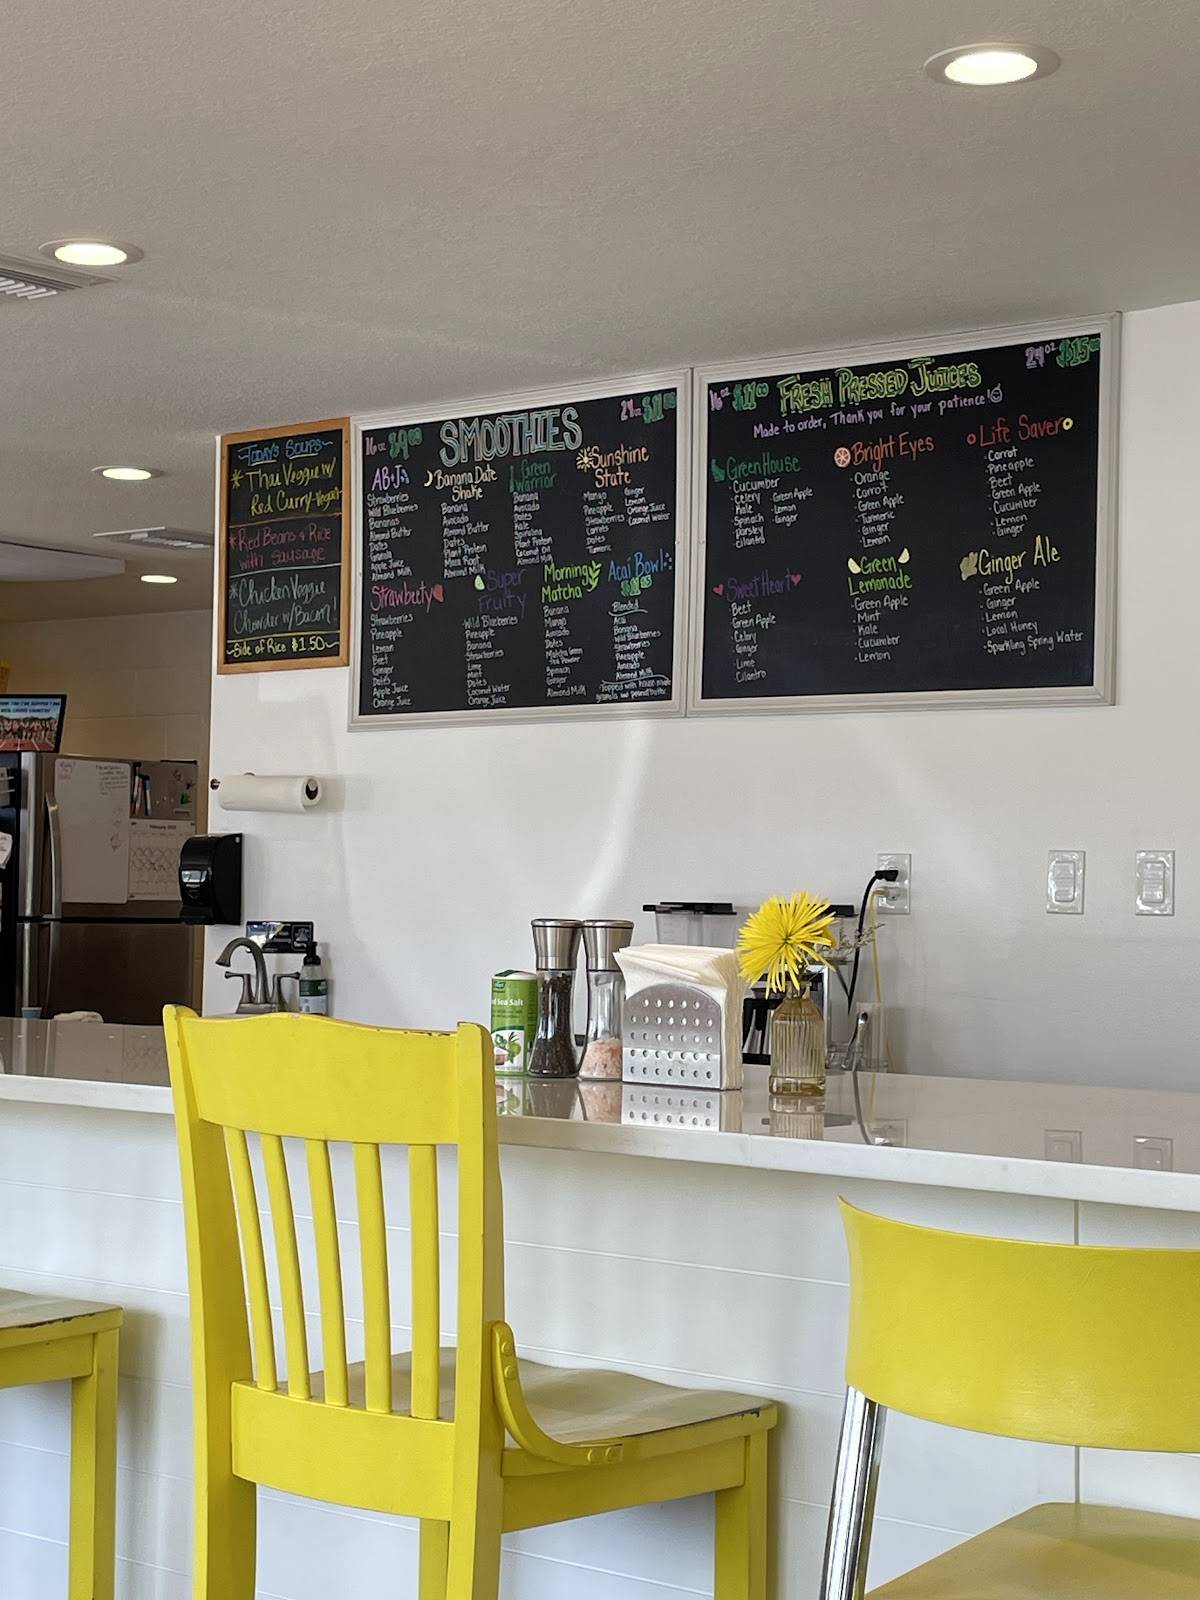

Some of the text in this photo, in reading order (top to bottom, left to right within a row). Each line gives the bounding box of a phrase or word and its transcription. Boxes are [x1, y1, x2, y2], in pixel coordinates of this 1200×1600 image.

[777, 374, 833, 417] FRESH
[835, 369, 908, 408] PRESSED
[754, 423, 780, 438] Made
[783, 420, 795, 433] to
[829, 408, 865, 425] Thank
[867, 409, 883, 424] you
[890, 401, 906, 417] for
[910, 402, 932, 418] your
[439, 406, 582, 468] SMOOTHIES
[980, 414, 1064, 447] Life Saver
[590, 443, 649, 469] Sunshine
[851, 432, 934, 472] Bright Eyes
[988, 446, 1018, 461] Carrot
[521, 459, 551, 478] Green
[987, 457, 1035, 474] Pineapple
[245, 469, 281, 491] Thai
[283, 463, 319, 486] Veggie
[434, 464, 498, 490] Banana Date
[515, 472, 558, 492] Warrior
[595, 466, 631, 488] State
[733, 478, 780, 493] Cucumber
[854, 470, 890, 486] Orange
[989, 472, 1012, 489] Beet
[452, 484, 483, 502] Shake
[772, 487, 813, 502] Green Apple
[856, 480, 888, 499] Carrot
[992, 482, 1041, 499] Green Apple
[251, 494, 273, 516] Red
[277, 490, 312, 513] Curry
[774, 504, 797, 514] Lemon
[858, 493, 904, 511] Green Apple
[993, 498, 1038, 514] Cucumber
[858, 511, 895, 524] Turmeric
[995, 514, 1027, 527] Lemon
[238, 528, 260, 551] Red
[263, 527, 296, 547] Beans
[308, 522, 331, 542] Rice
[862, 522, 889, 535] Ginger
[997, 523, 1024, 537] Ginger
[862, 534, 891, 548] Lemon
[240, 547, 325, 570] with Sausage
[634, 552, 664, 577] Bowl
[860, 556, 897, 574] Green
[979, 535, 1060, 584] Ginger Ale
[487, 569, 527, 595] Super
[544, 562, 588, 586] Morning
[848, 568, 912, 595] Lemonade
[239, 574, 326, 607] Chicken Veggie
[541, 584, 582, 603] Matcha
[983, 578, 1040, 595] Green Apple
[731, 600, 752, 616] Beet
[855, 594, 908, 610] Green Apple
[986, 597, 1016, 609] Ginger
[234, 609, 279, 634] Chowder
[732, 612, 776, 629] Green Apple
[858, 610, 880, 623] Mint
[985, 610, 1018, 622] Lemon
[734, 630, 757, 643] Celery
[858, 624, 878, 635] Kale
[986, 621, 1038, 637] Local Honey
[233, 641, 252, 657] Side
[255, 639, 265, 654] of
[267, 637, 286, 654] Rice
[858, 634, 900, 648] Cucumber
[987, 629, 1083, 655] Sparkling Spring Water
[736, 658, 756, 670] Lime
[859, 651, 891, 662] Lemon
[736, 669, 766, 682] Cilantro
[508, 998, 523, 1006] Salt
